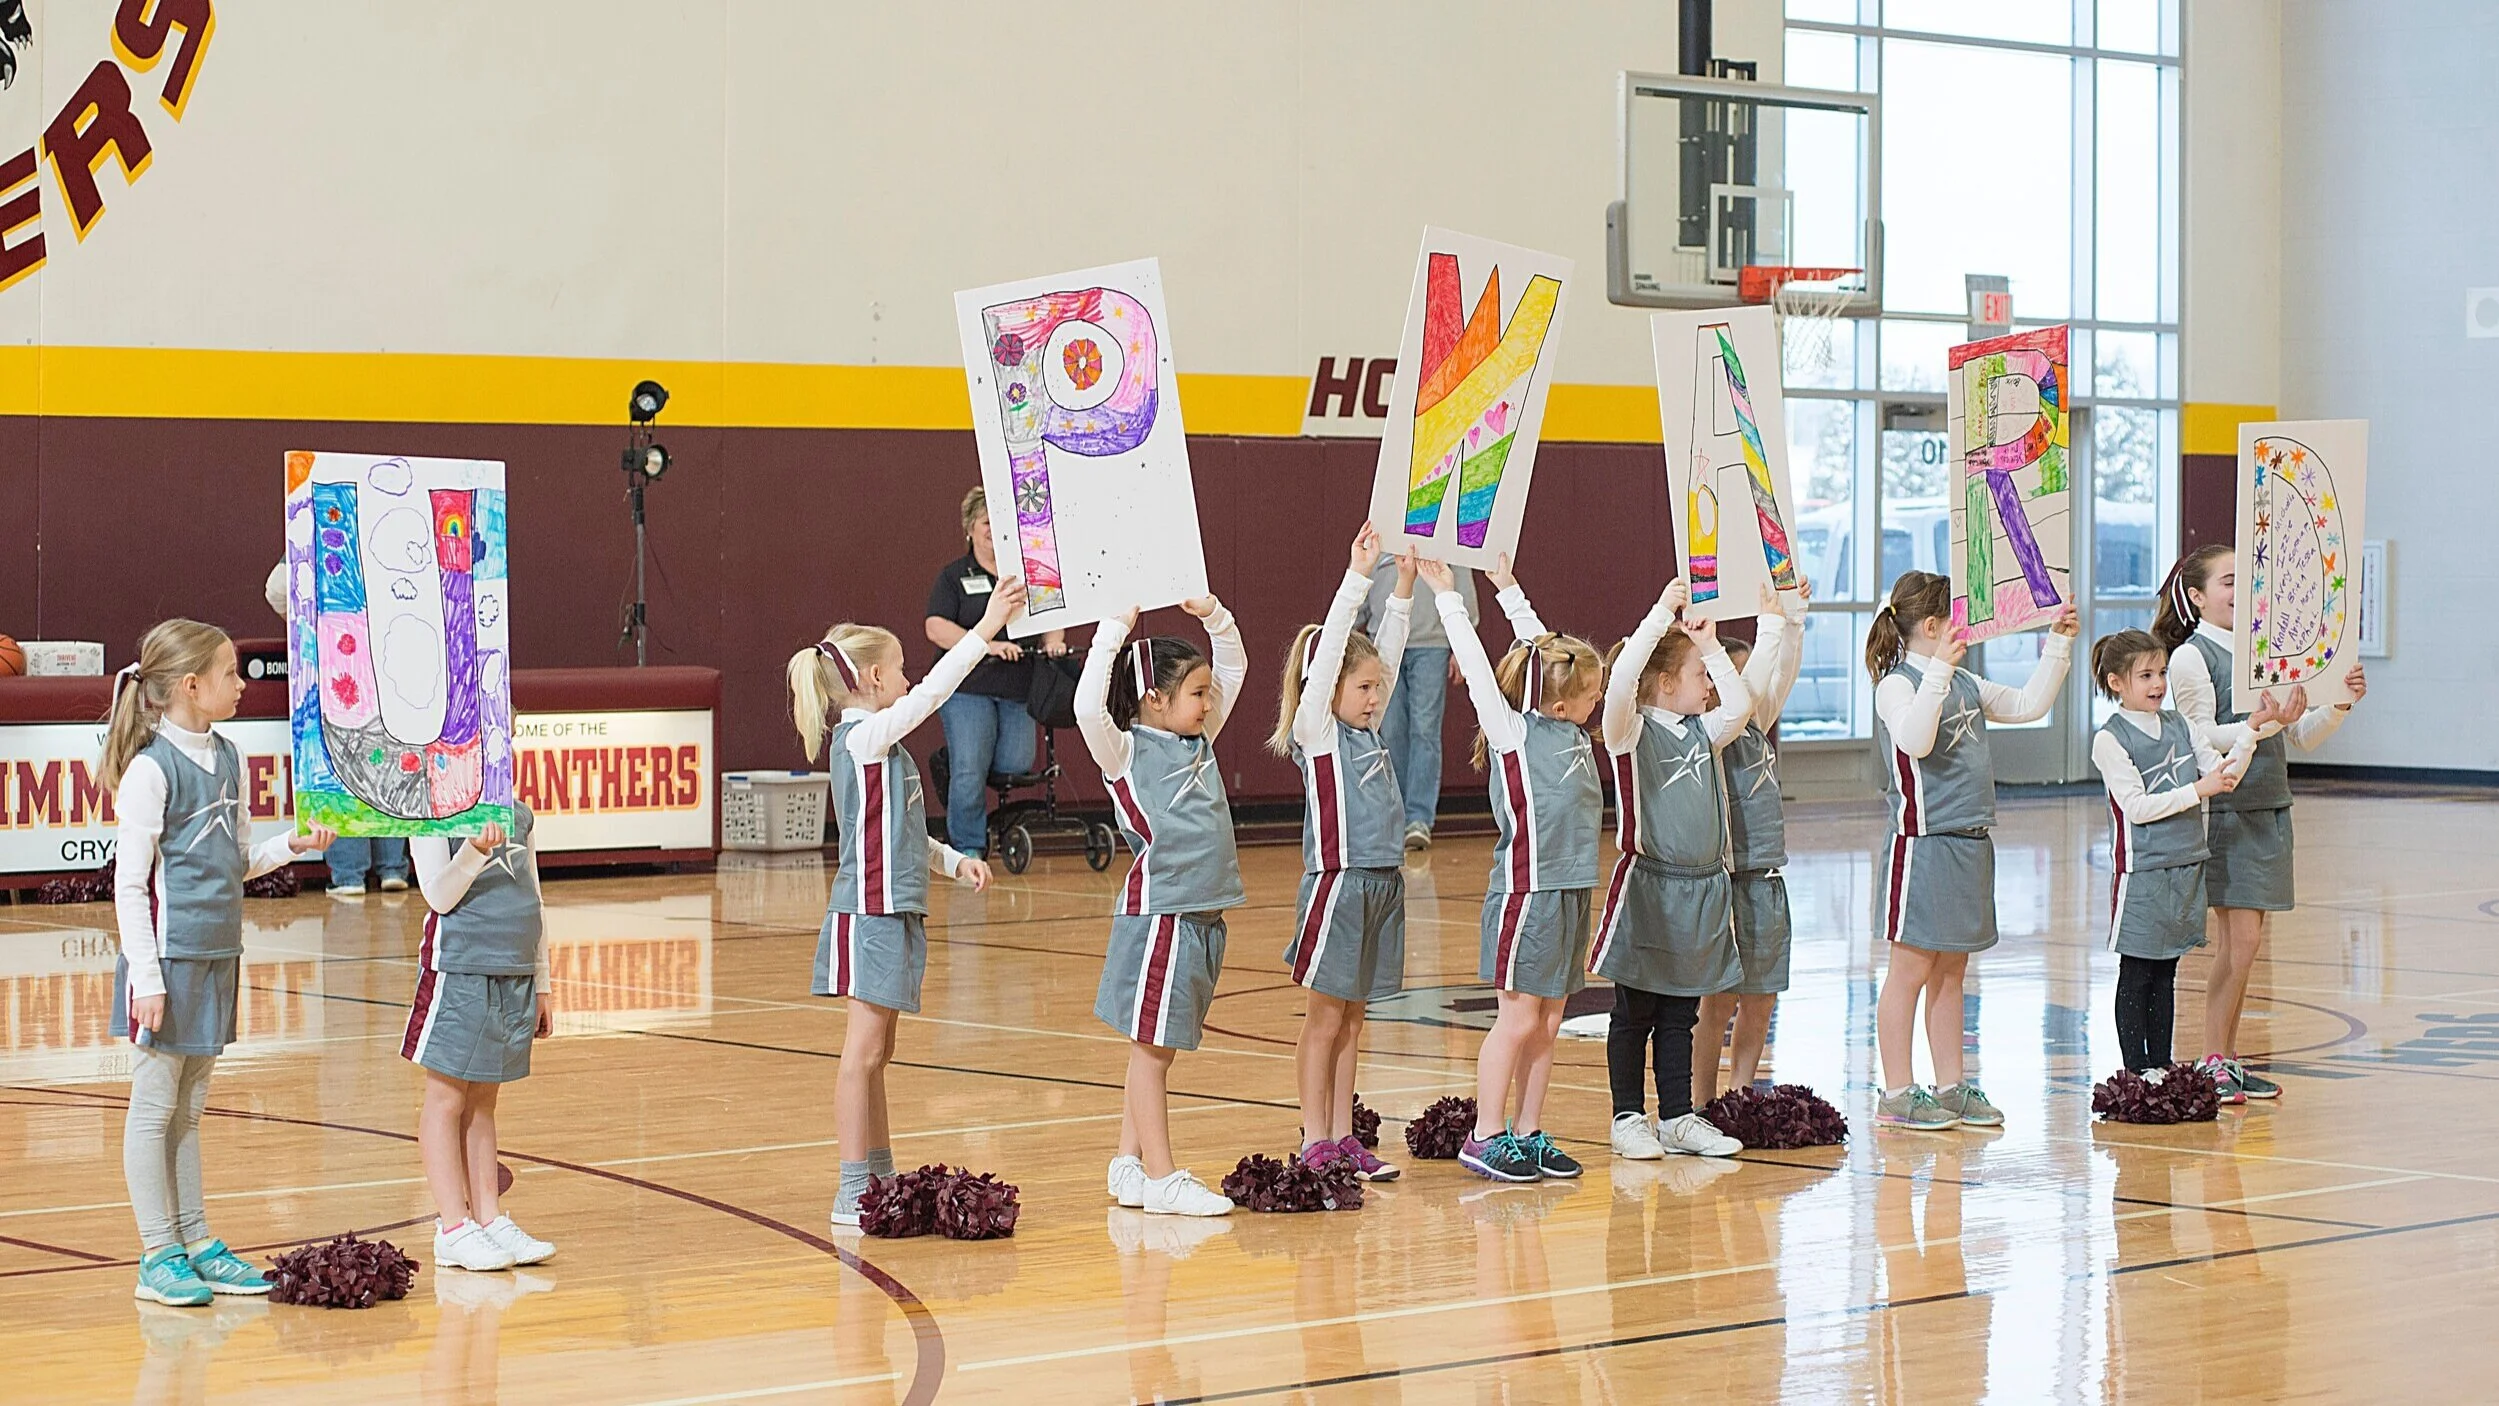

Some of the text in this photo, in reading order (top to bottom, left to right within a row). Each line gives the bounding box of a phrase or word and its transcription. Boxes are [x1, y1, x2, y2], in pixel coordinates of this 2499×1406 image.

[1985, 294, 2009, 322] EXIT
[1308, 356, 1399, 418] HO
[1404, 252, 1563, 549] W
[982, 286, 1158, 617] P
[1687, 321, 1799, 605] A
[1963, 348, 2063, 626] R
[2248, 436, 2349, 690] D
[2274, 569, 2293, 605] Avery
[311, 481, 484, 820] U
[2271, 611, 2290, 652] Kendall
[266, 661, 289, 675] BONU
[515, 721, 608, 737] OME OF THE
[511, 744, 702, 817] ANTHERS
[61, 839, 118, 861] CRY
